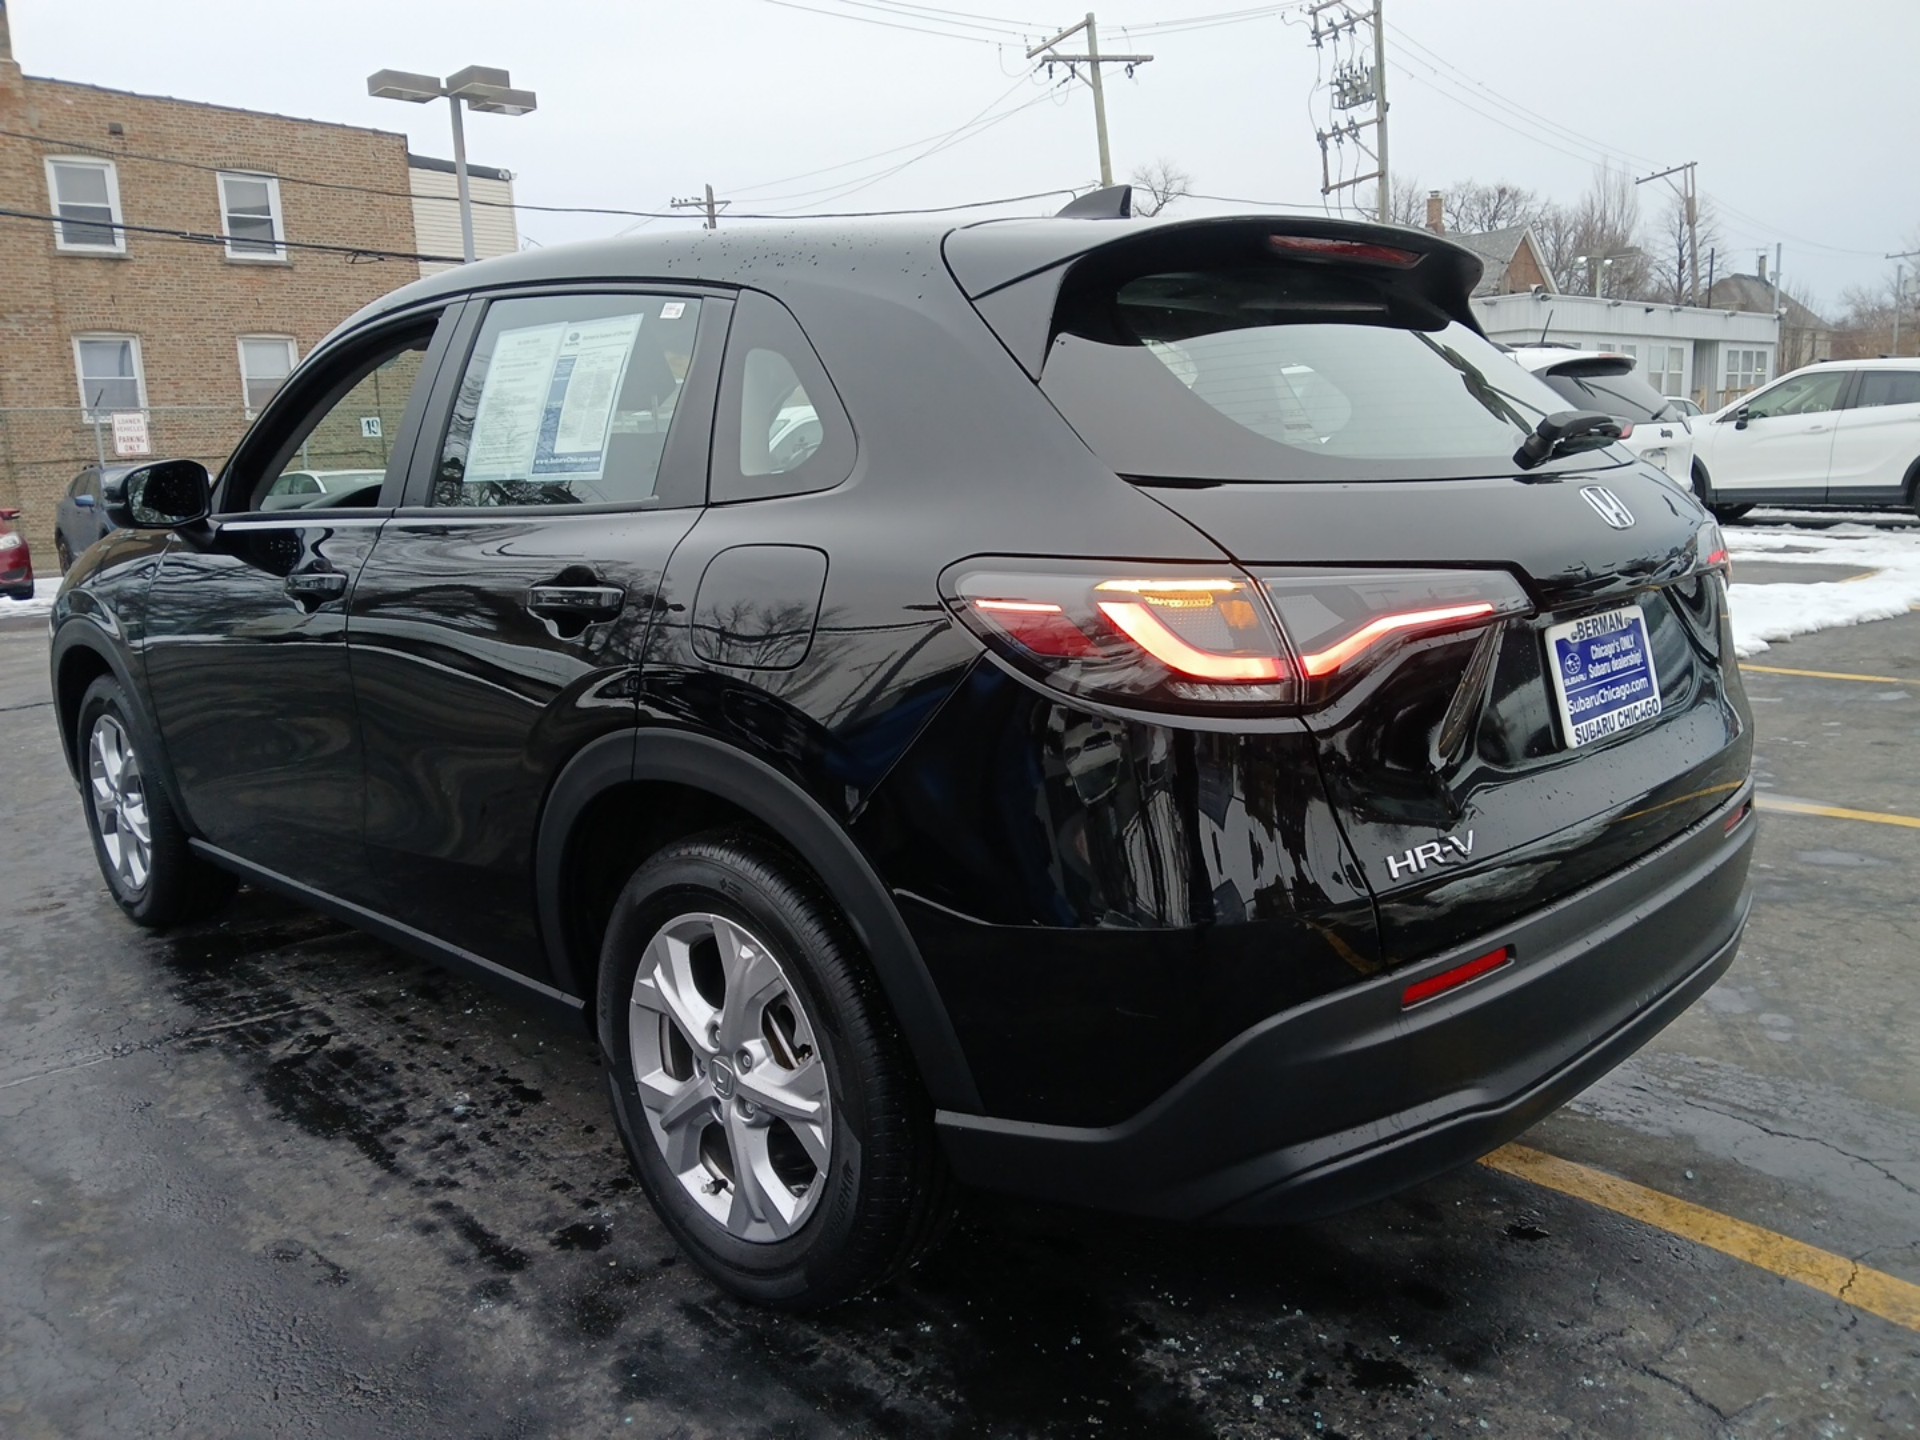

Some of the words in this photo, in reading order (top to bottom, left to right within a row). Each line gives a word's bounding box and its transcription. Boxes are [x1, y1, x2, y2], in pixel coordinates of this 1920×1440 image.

[118, 435, 145, 443] PARKING
[124, 444, 140, 452] ONLY
[1576, 611, 1624, 641] BERMAN
[1590, 641, 1620, 660] Chicago's
[1619, 634, 1635, 650] ONLY
[1588, 661, 1611, 678] Subaru
[1567, 676, 1649, 715] SubaruChicago.com
[1574, 714, 1615, 745] SUBARU
[1617, 698, 1660, 729] CHICAGO
[1386, 829, 1474, 879] HR-V
